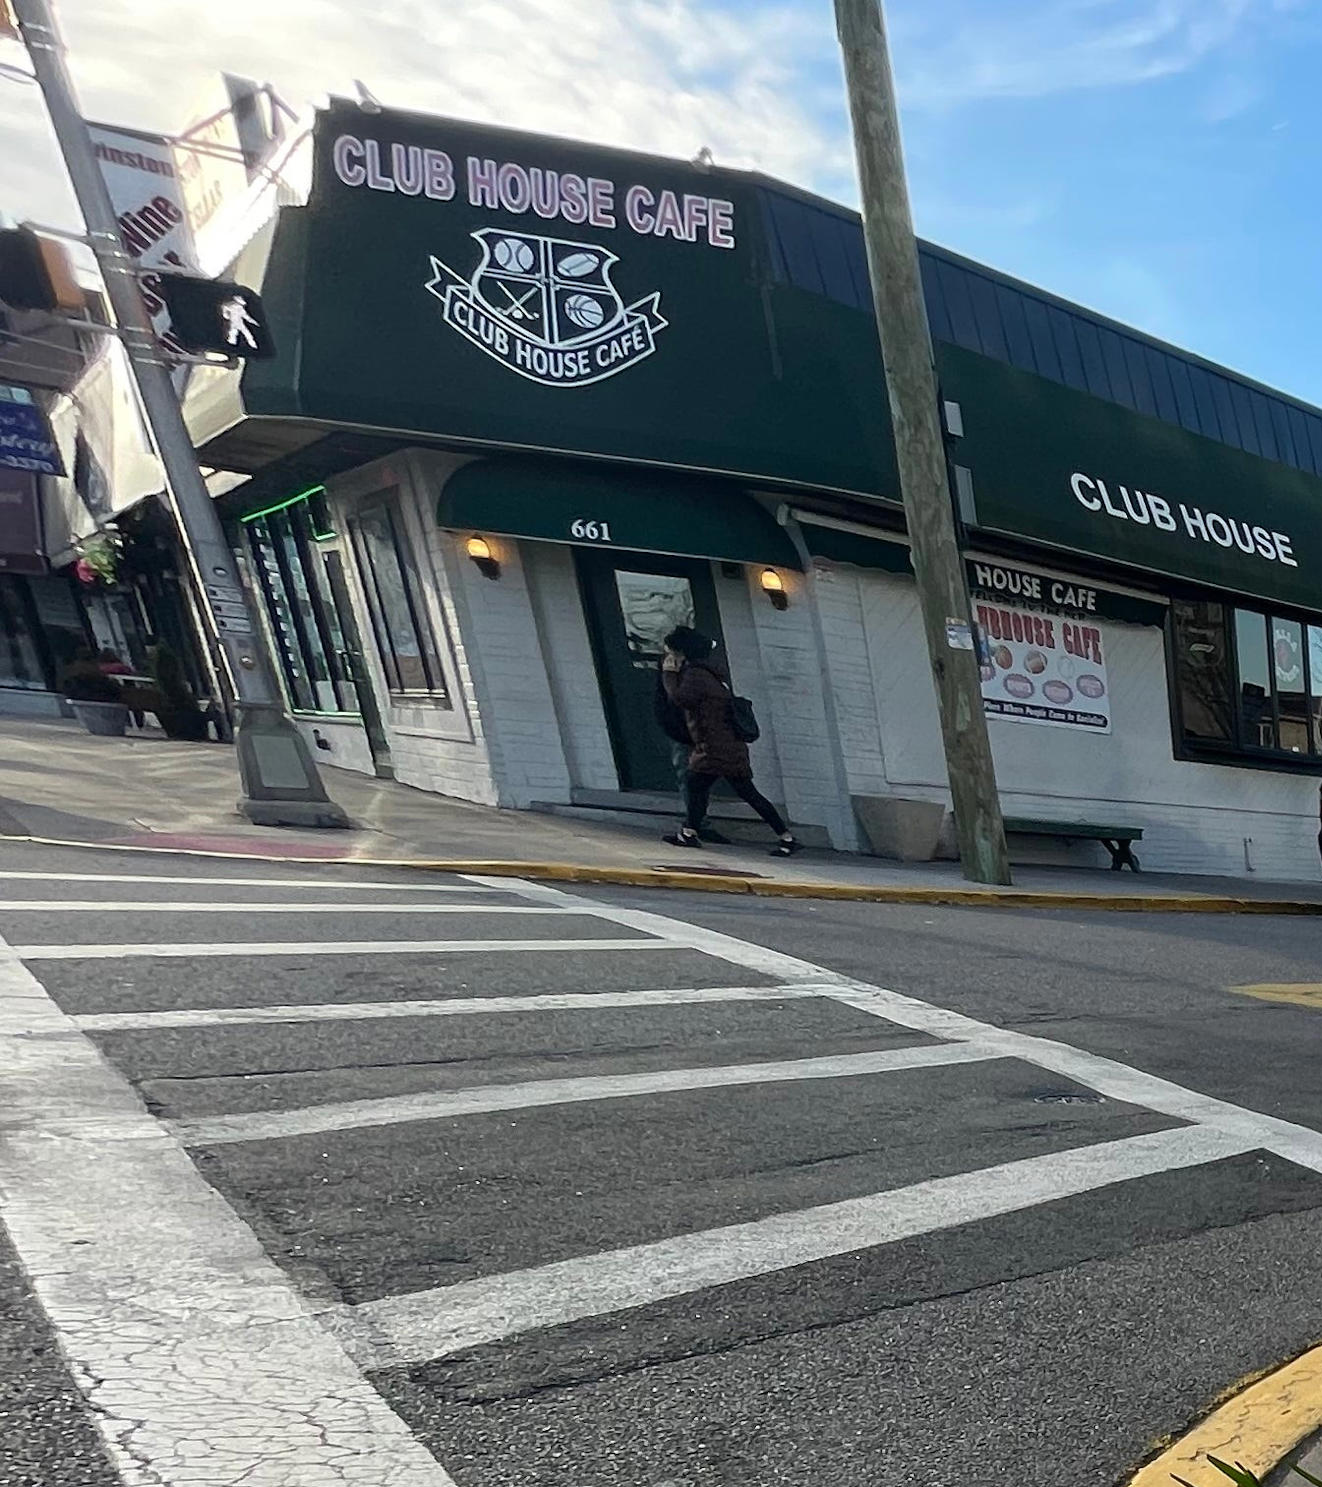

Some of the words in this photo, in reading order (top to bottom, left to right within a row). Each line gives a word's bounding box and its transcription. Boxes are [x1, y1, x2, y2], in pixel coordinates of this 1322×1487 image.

[333, 134, 455, 201] CLUB
[466, 155, 617, 229] HOUSE
[625, 184, 736, 249] CAFE
[453, 301, 510, 355] CLUB
[515, 338, 591, 378] HOUSE
[595, 325, 646, 367] CAFÉ
[571, 519, 612, 541] 661
[1070, 472, 1177, 532] CLUB
[1178, 504, 1298, 567] HOUSE
[974, 564, 1042, 599] HOUSE
[1052, 583, 1097, 611] CAFE
[1061, 622, 1102, 665] CAFE
